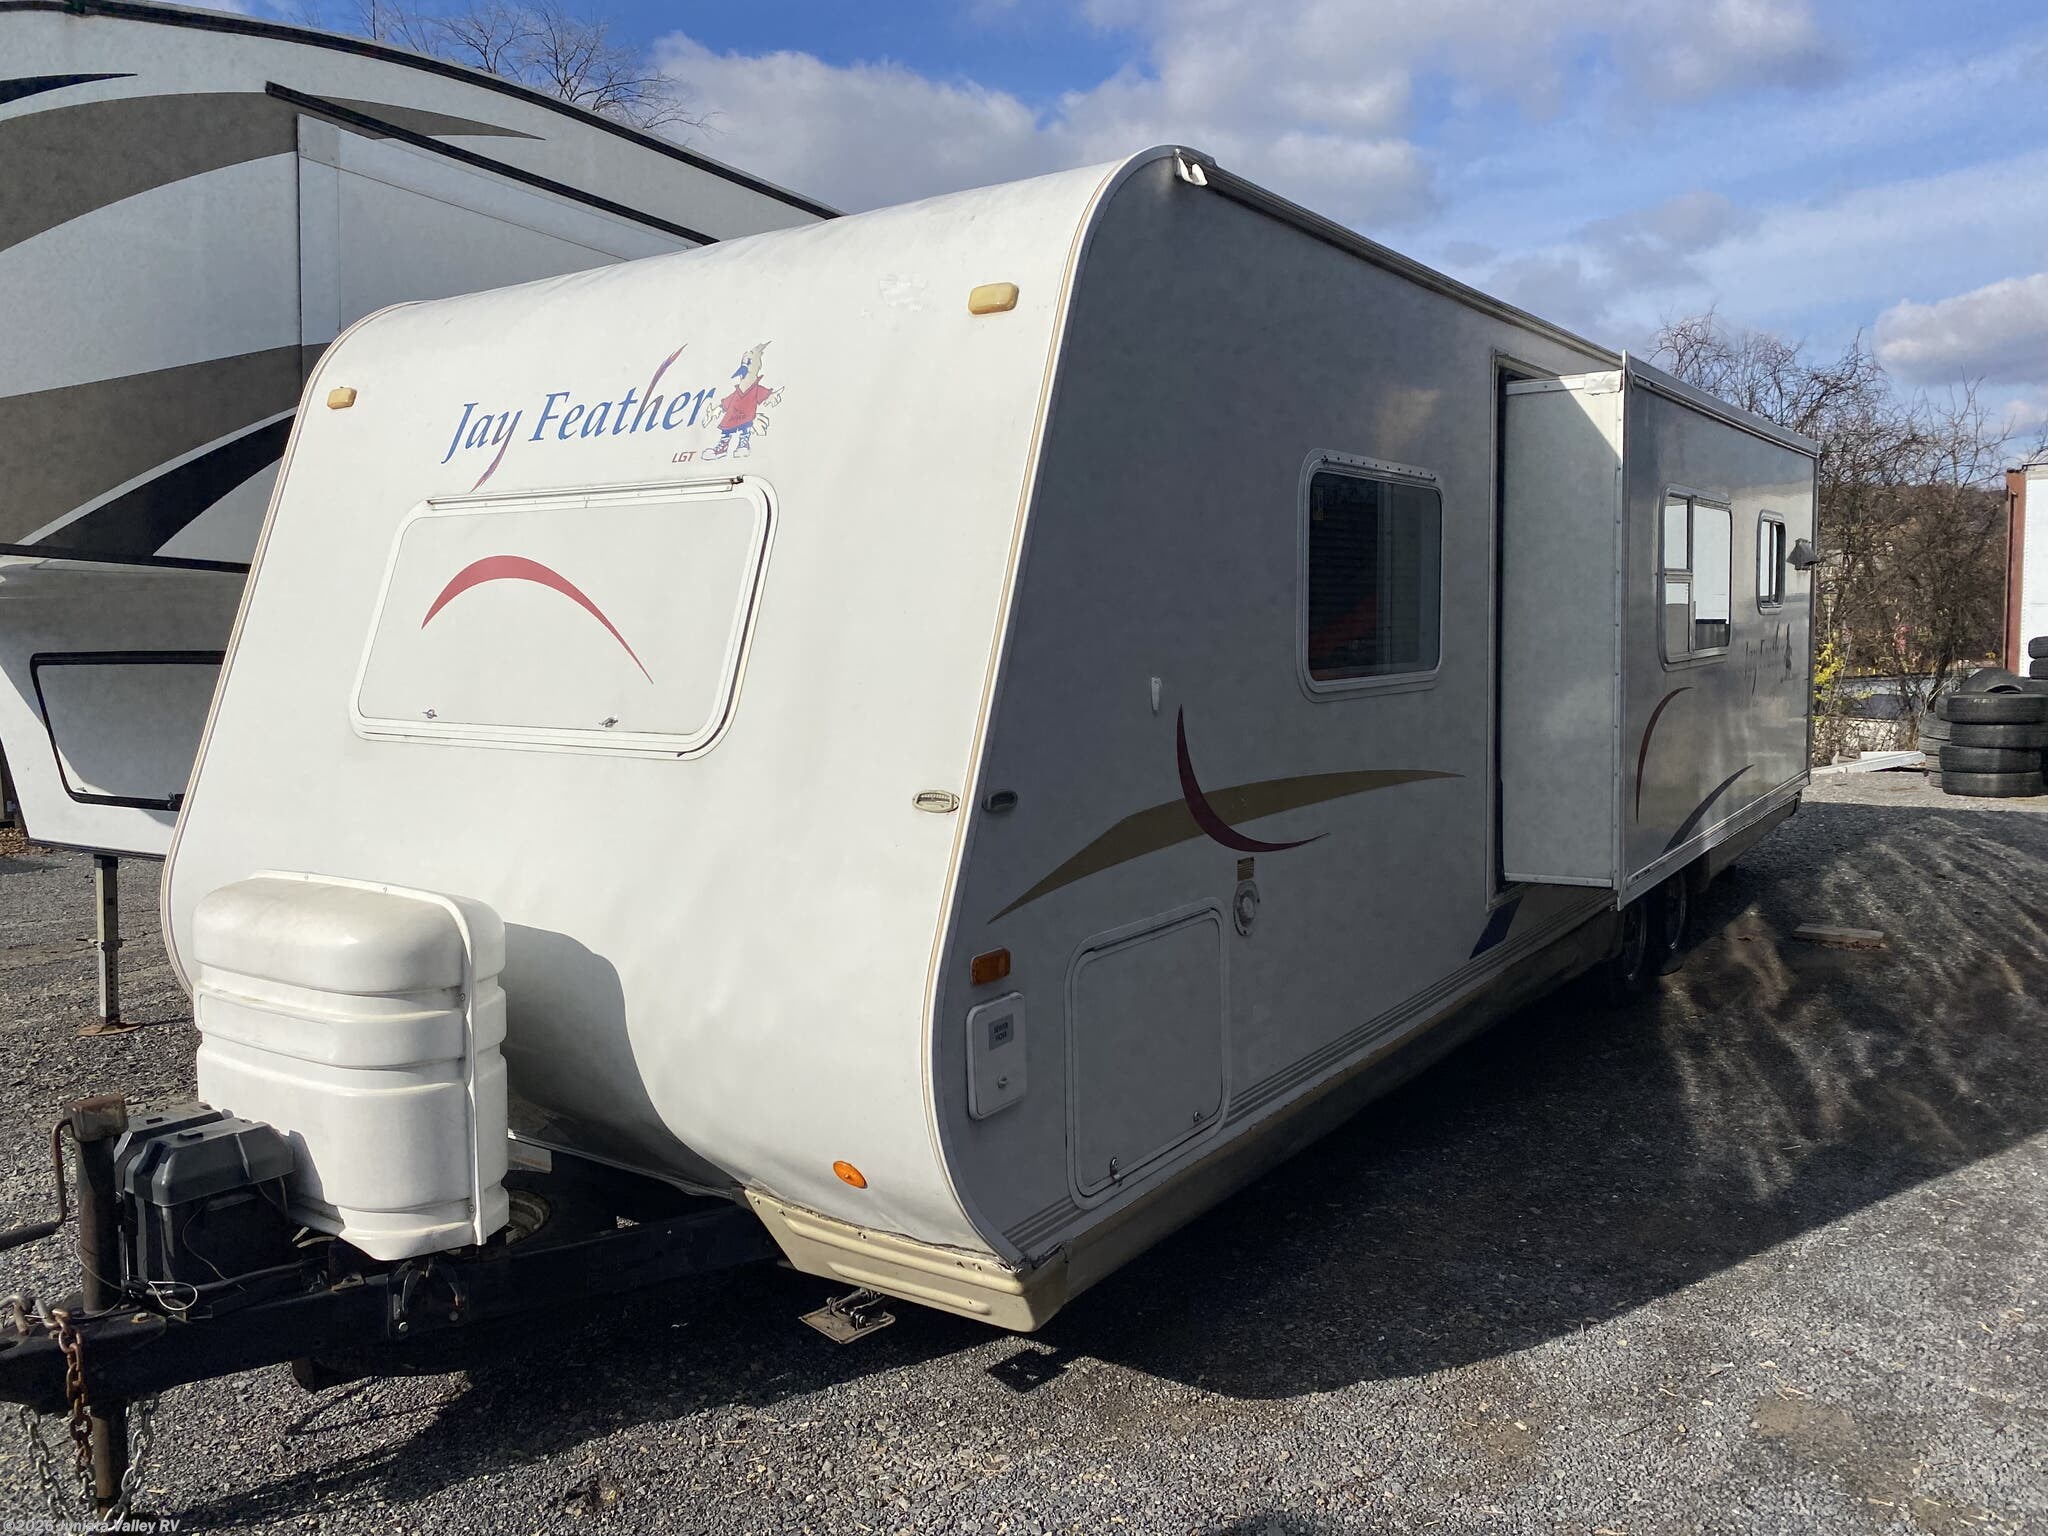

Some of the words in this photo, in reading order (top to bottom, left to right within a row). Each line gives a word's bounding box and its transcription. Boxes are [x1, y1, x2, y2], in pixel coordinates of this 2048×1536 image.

[440, 401, 523, 493] Jay
[528, 342, 716, 442] Feather
[672, 451, 697, 463] LGT
